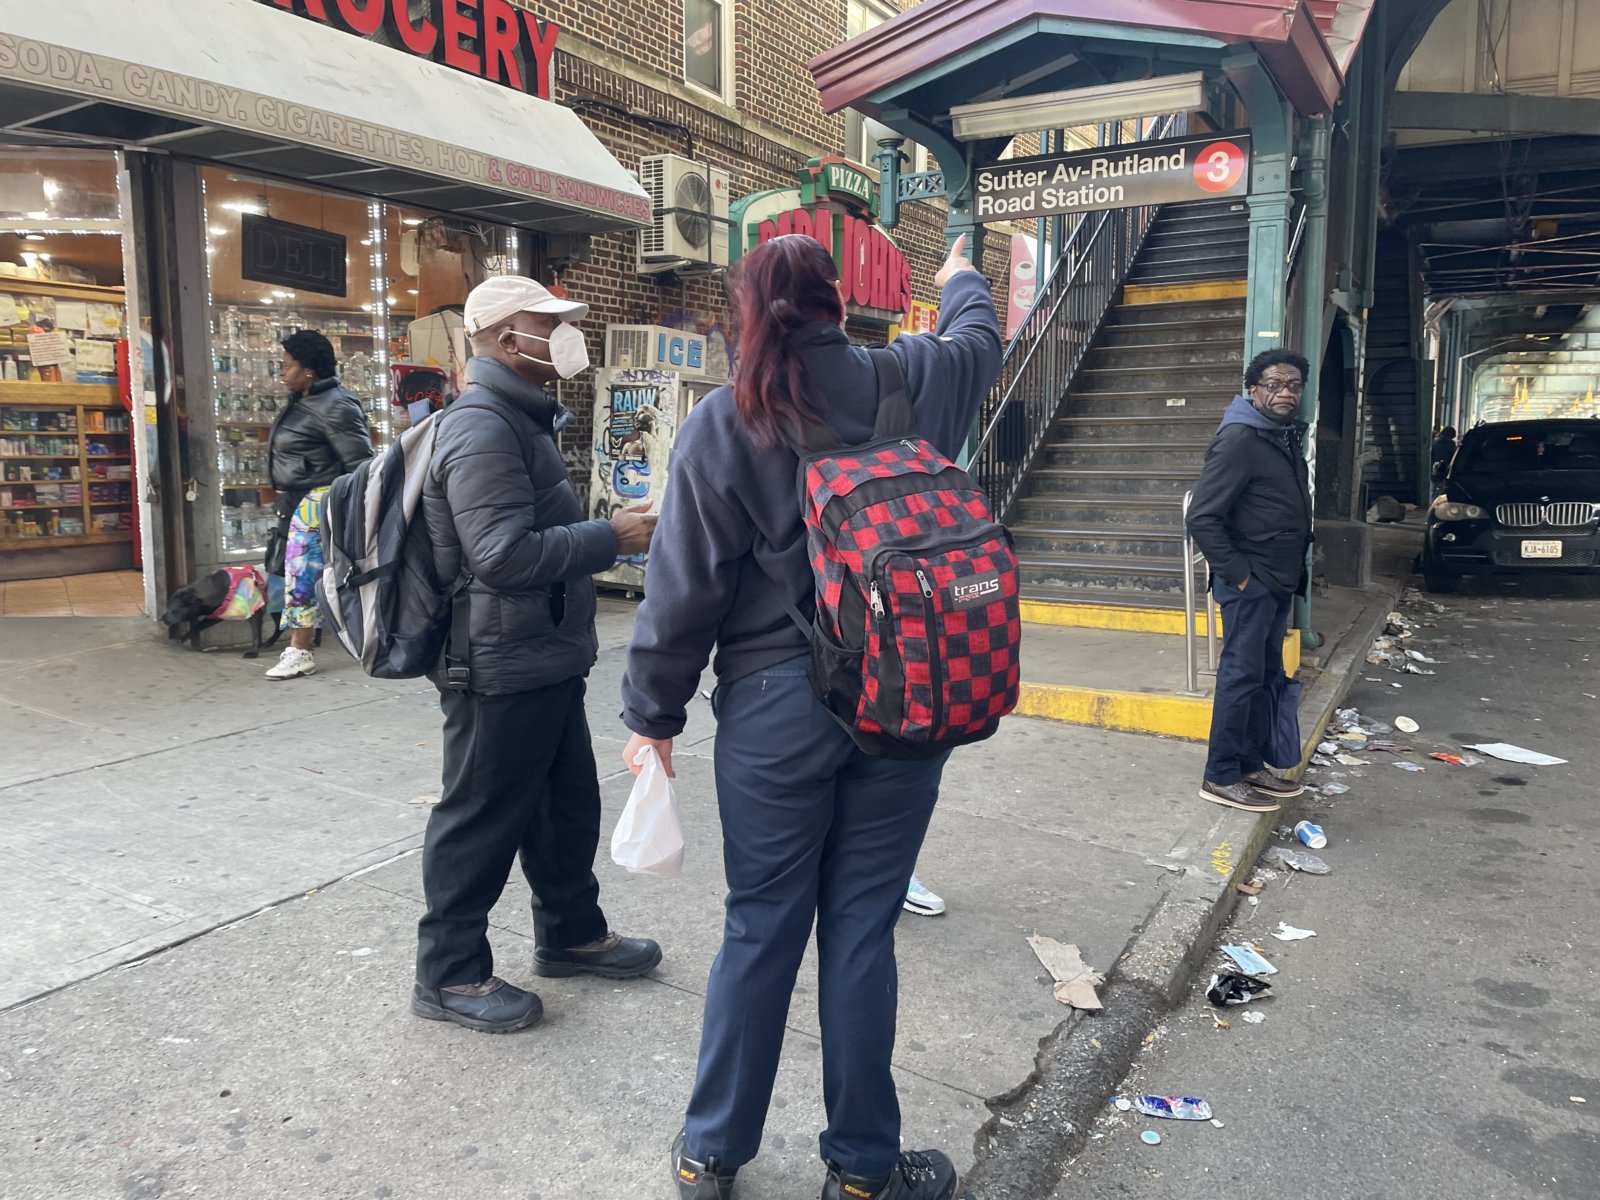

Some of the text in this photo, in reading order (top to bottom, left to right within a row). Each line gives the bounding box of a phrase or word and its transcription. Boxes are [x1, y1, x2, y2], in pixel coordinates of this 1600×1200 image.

[273, 0, 560, 101] CERY
[437, 143, 483, 178] HOT
[488, 158, 502, 183] &
[506, 162, 551, 194] COLD
[555, 175, 650, 220] SANDWICHES
[831, 166, 870, 200] PIZZA
[978, 148, 1186, 193] Sutter Av-Rutland
[1206, 151, 1230, 183] 3
[978, 183, 1124, 216] Road Station
[255, 230, 337, 281] DELI
[657, 333, 703, 369] ICE
[614, 388, 657, 411] RAUW
[954, 578, 999, 597] trans
